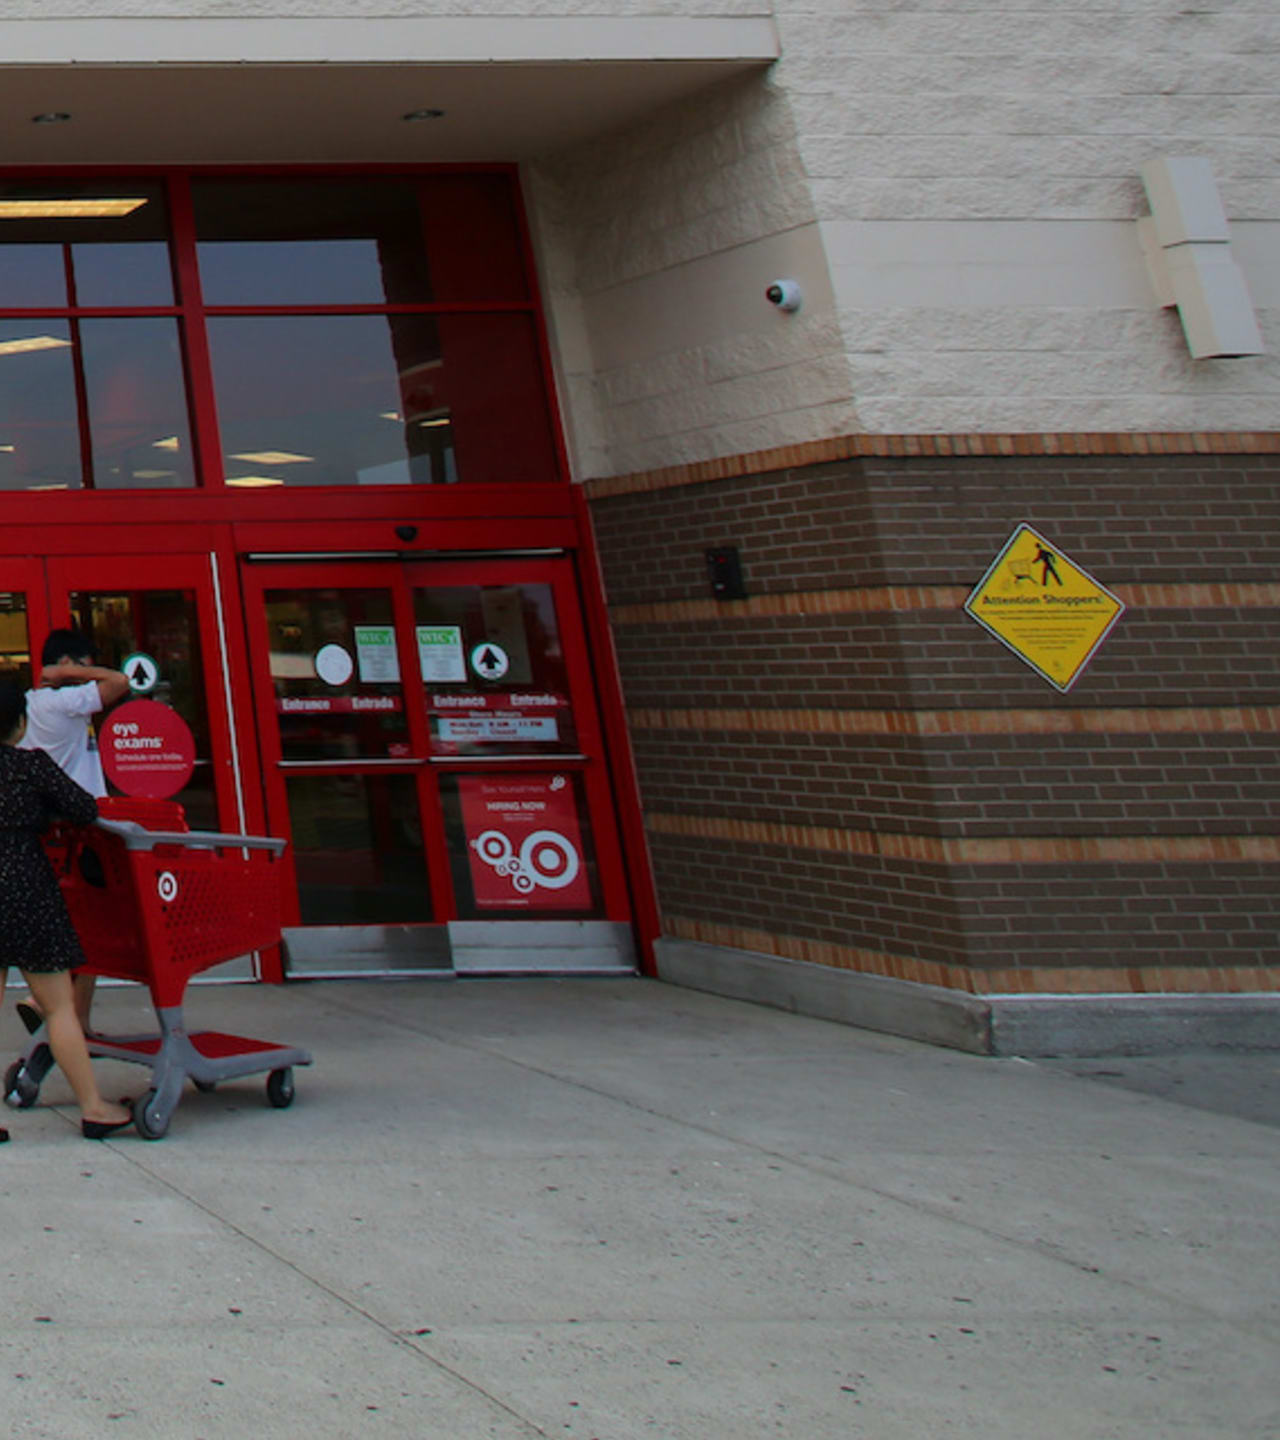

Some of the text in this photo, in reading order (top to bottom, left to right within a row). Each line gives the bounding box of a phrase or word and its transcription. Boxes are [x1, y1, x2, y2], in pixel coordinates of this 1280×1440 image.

[983, 595, 1039, 605] Attention
[419, 632, 445, 644] WIC
[282, 696, 394, 711] Entrance Entrada
[433, 693, 557, 707] Entrance Entrada
[112, 722, 139, 737] eye
[486, 801, 546, 811] HIRING NOW
